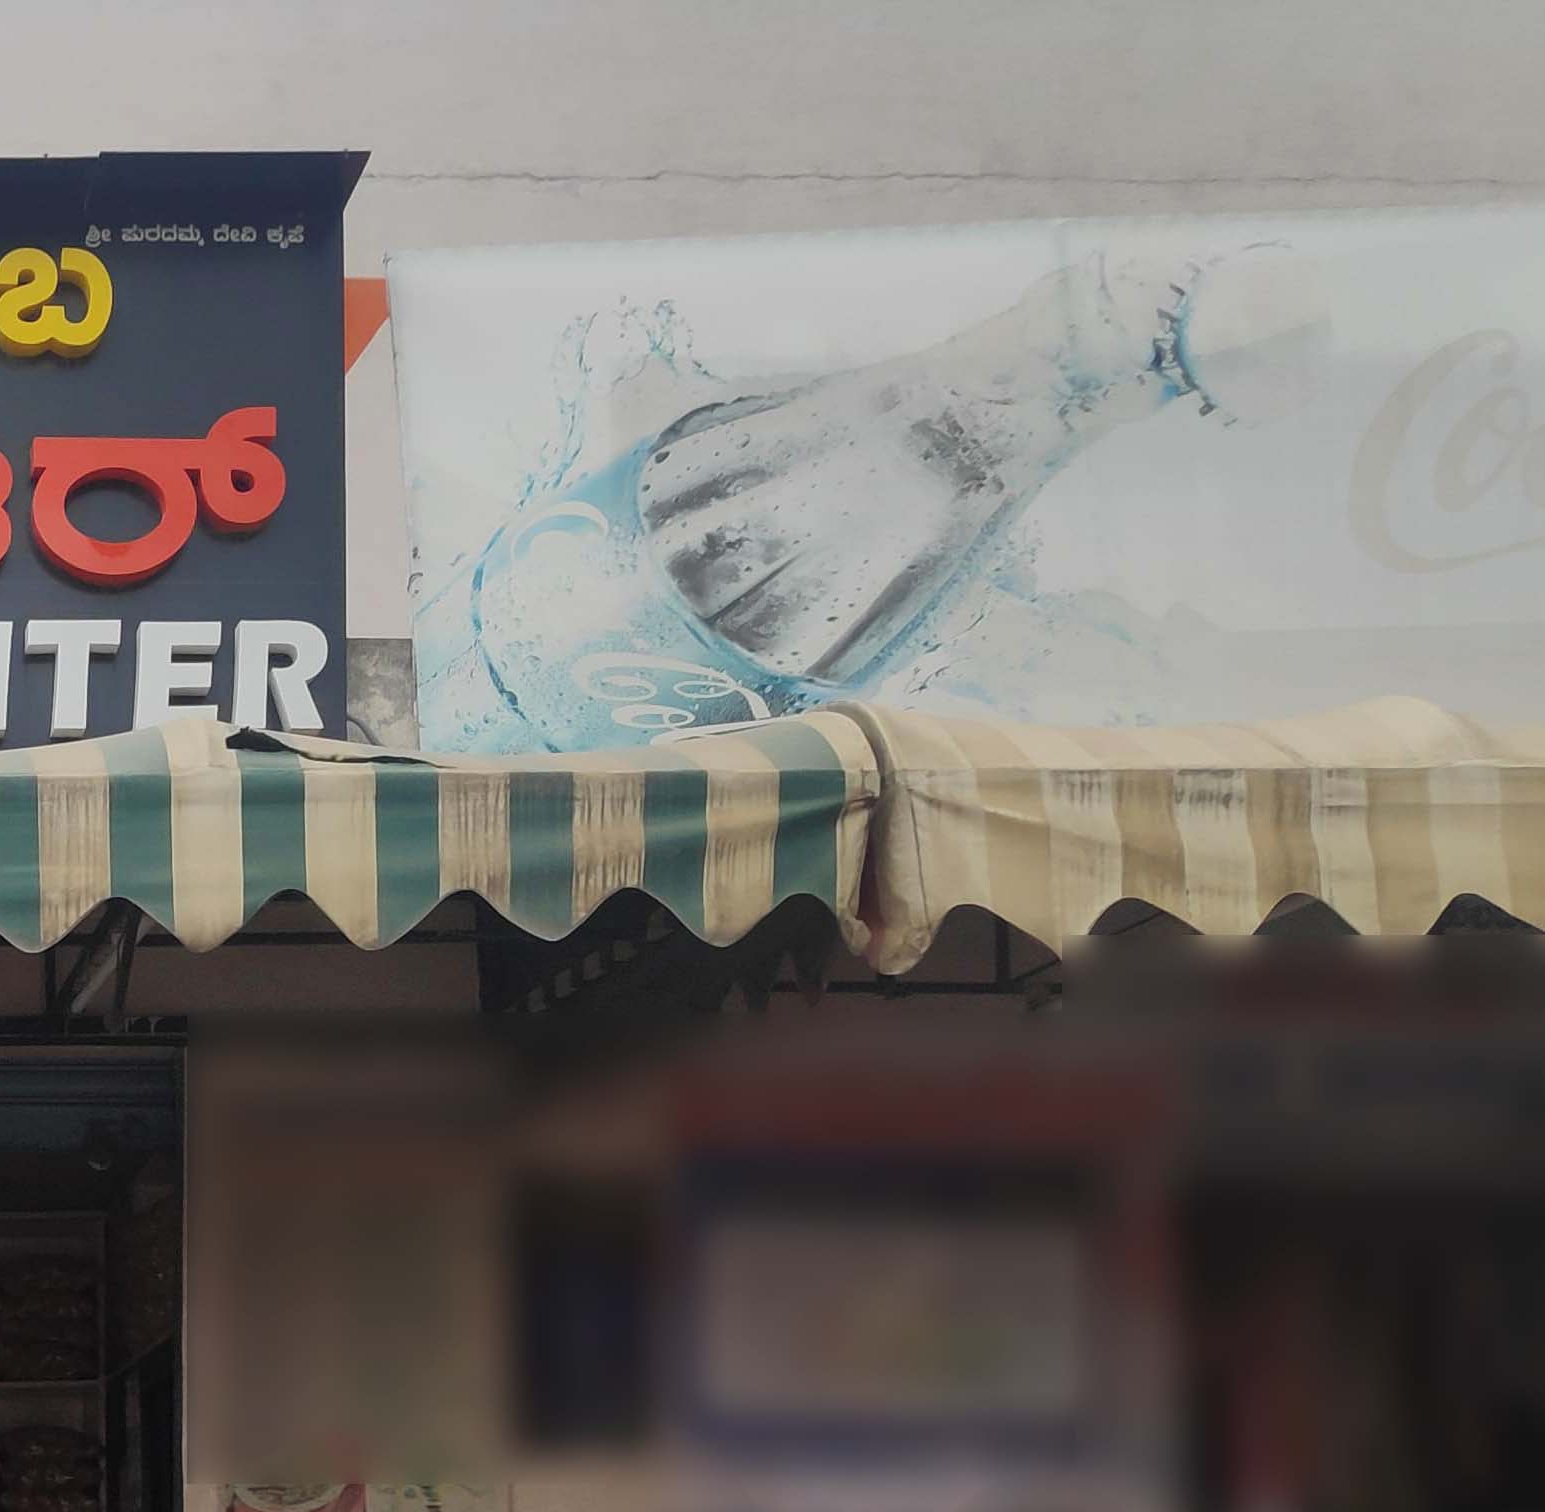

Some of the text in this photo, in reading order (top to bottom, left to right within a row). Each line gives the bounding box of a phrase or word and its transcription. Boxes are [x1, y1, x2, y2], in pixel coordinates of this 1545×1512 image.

[85, 224, 111, 247] ಶ್ರೀ
[213, 224, 256, 242] ದೇವಿ
[267, 224, 304, 248] ಕೃಪೆ
